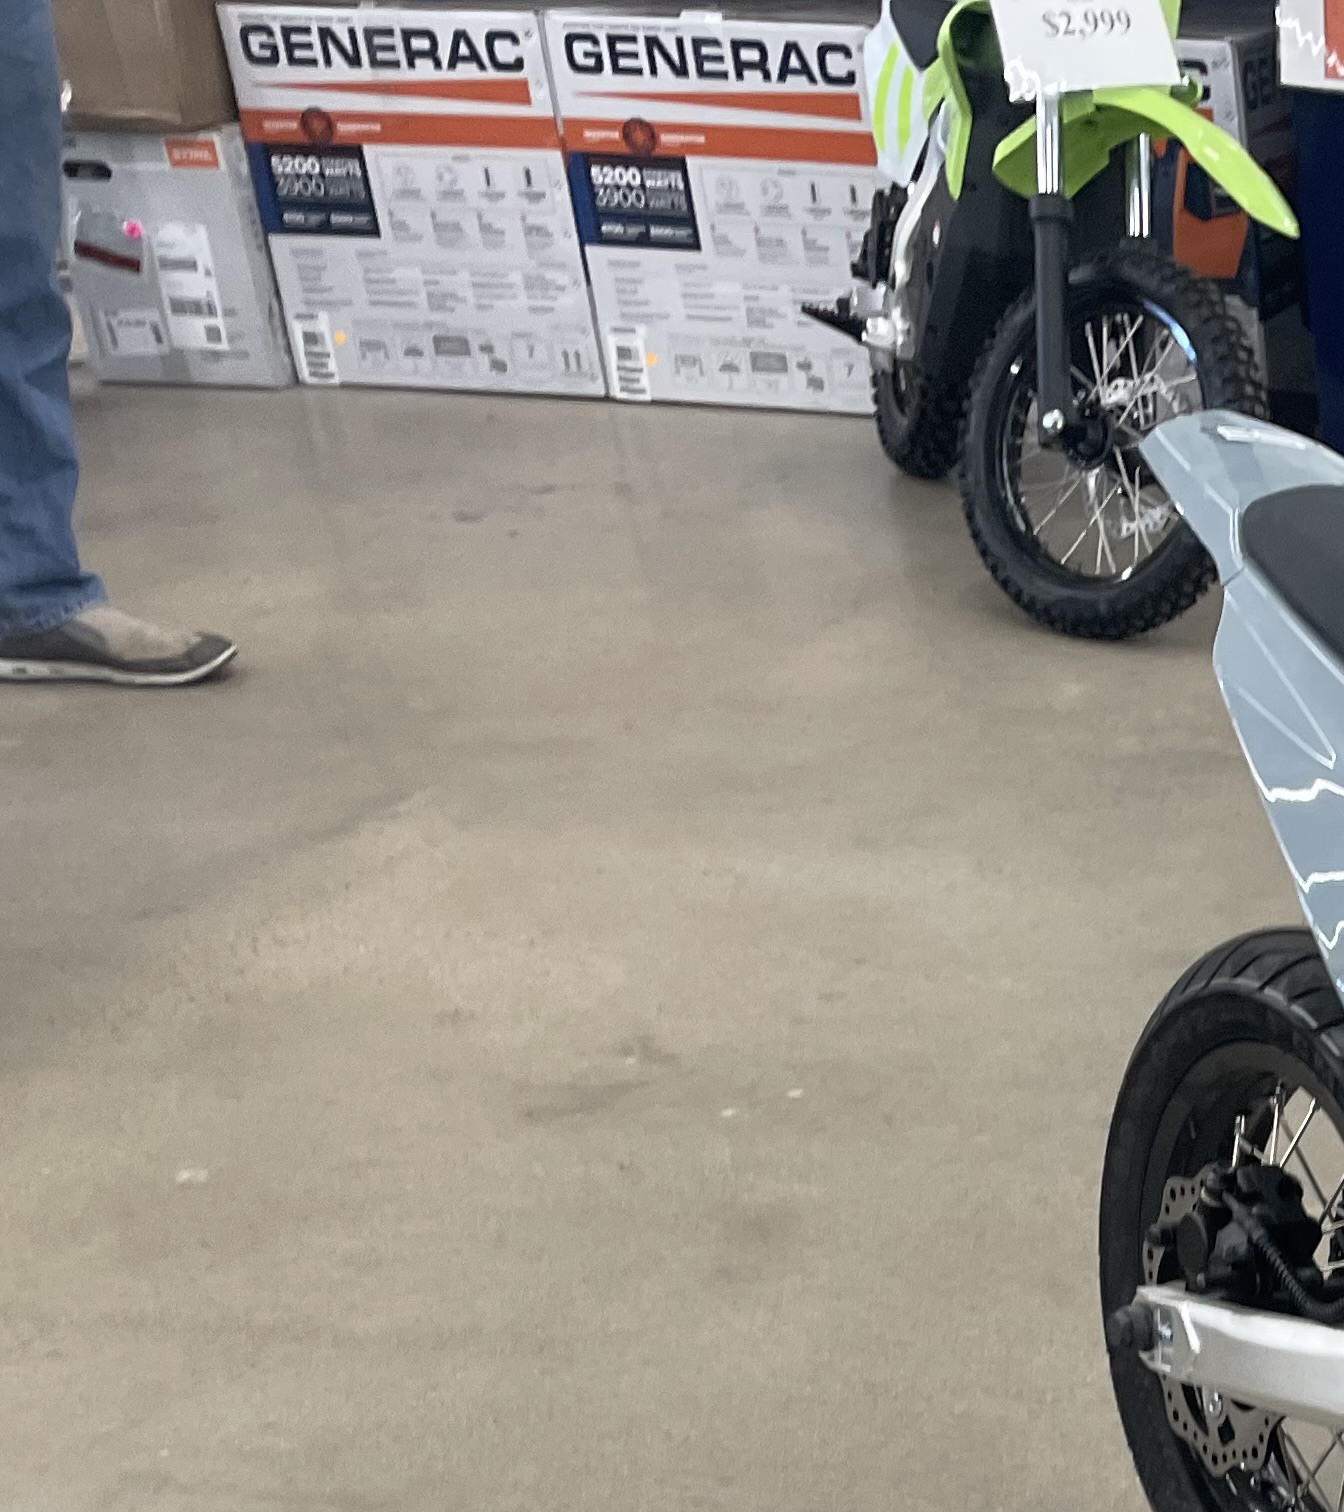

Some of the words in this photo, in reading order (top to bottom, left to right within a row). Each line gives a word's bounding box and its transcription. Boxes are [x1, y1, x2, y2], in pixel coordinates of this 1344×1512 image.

[239, 24, 525, 73] GENERAC
[1042, 9, 1132, 40] $2,999
[564, 32, 857, 86] GENERAC
